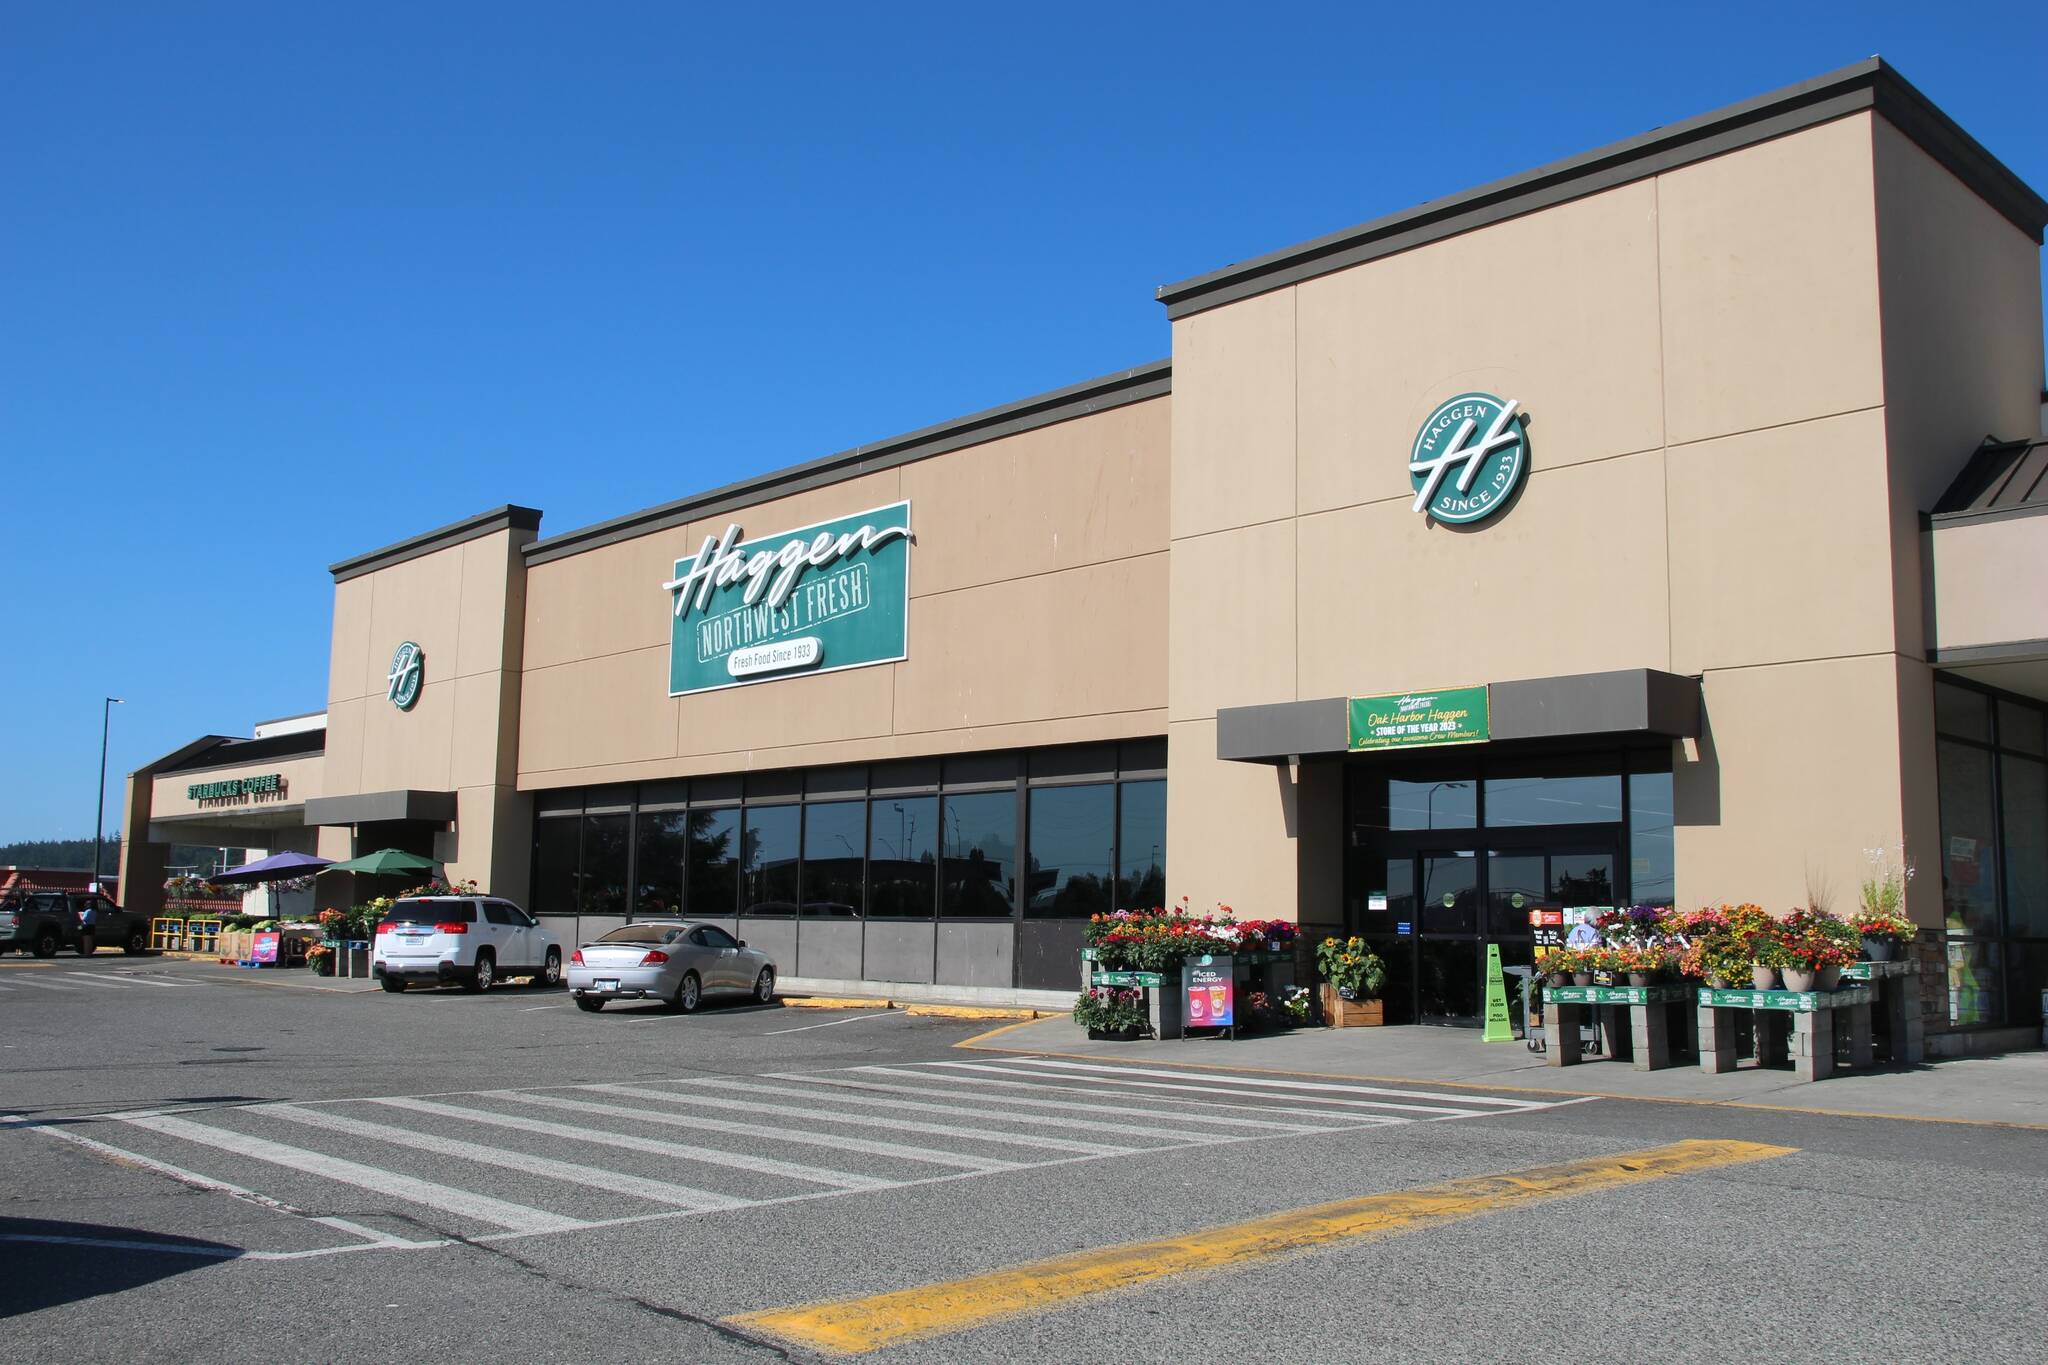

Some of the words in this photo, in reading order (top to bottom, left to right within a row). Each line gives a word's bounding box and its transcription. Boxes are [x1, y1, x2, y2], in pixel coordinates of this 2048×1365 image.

[1423, 405, 1488, 451] HAGGEN
[1408, 399, 1520, 513] H
[1440, 490, 1491, 511] SINCE
[1492, 455, 1513, 490] 1933
[662, 523, 914, 617] Haggen
[702, 591, 799, 657] NORTHWEST
[806, 570, 863, 622] FRESH
[734, 656, 753, 669] Fresh
[754, 651, 771, 666] Food
[772, 649, 792, 663] Since
[794, 643, 811, 659] 1933
[1368, 713, 1389, 727] Oak
[1390, 710, 1425, 724] Harbor
[1428, 708, 1468, 722] Haggen
[1376, 726, 1396, 736] STORE
[1396, 725, 1406, 735] OF
[1407, 724, 1420, 734] THE
[1421, 722, 1438, 732] YEAR
[1440, 721, 1456, 731] 2023
[188, 780, 240, 800] STARBUCKS
[242, 774, 279, 794] COFFEE
